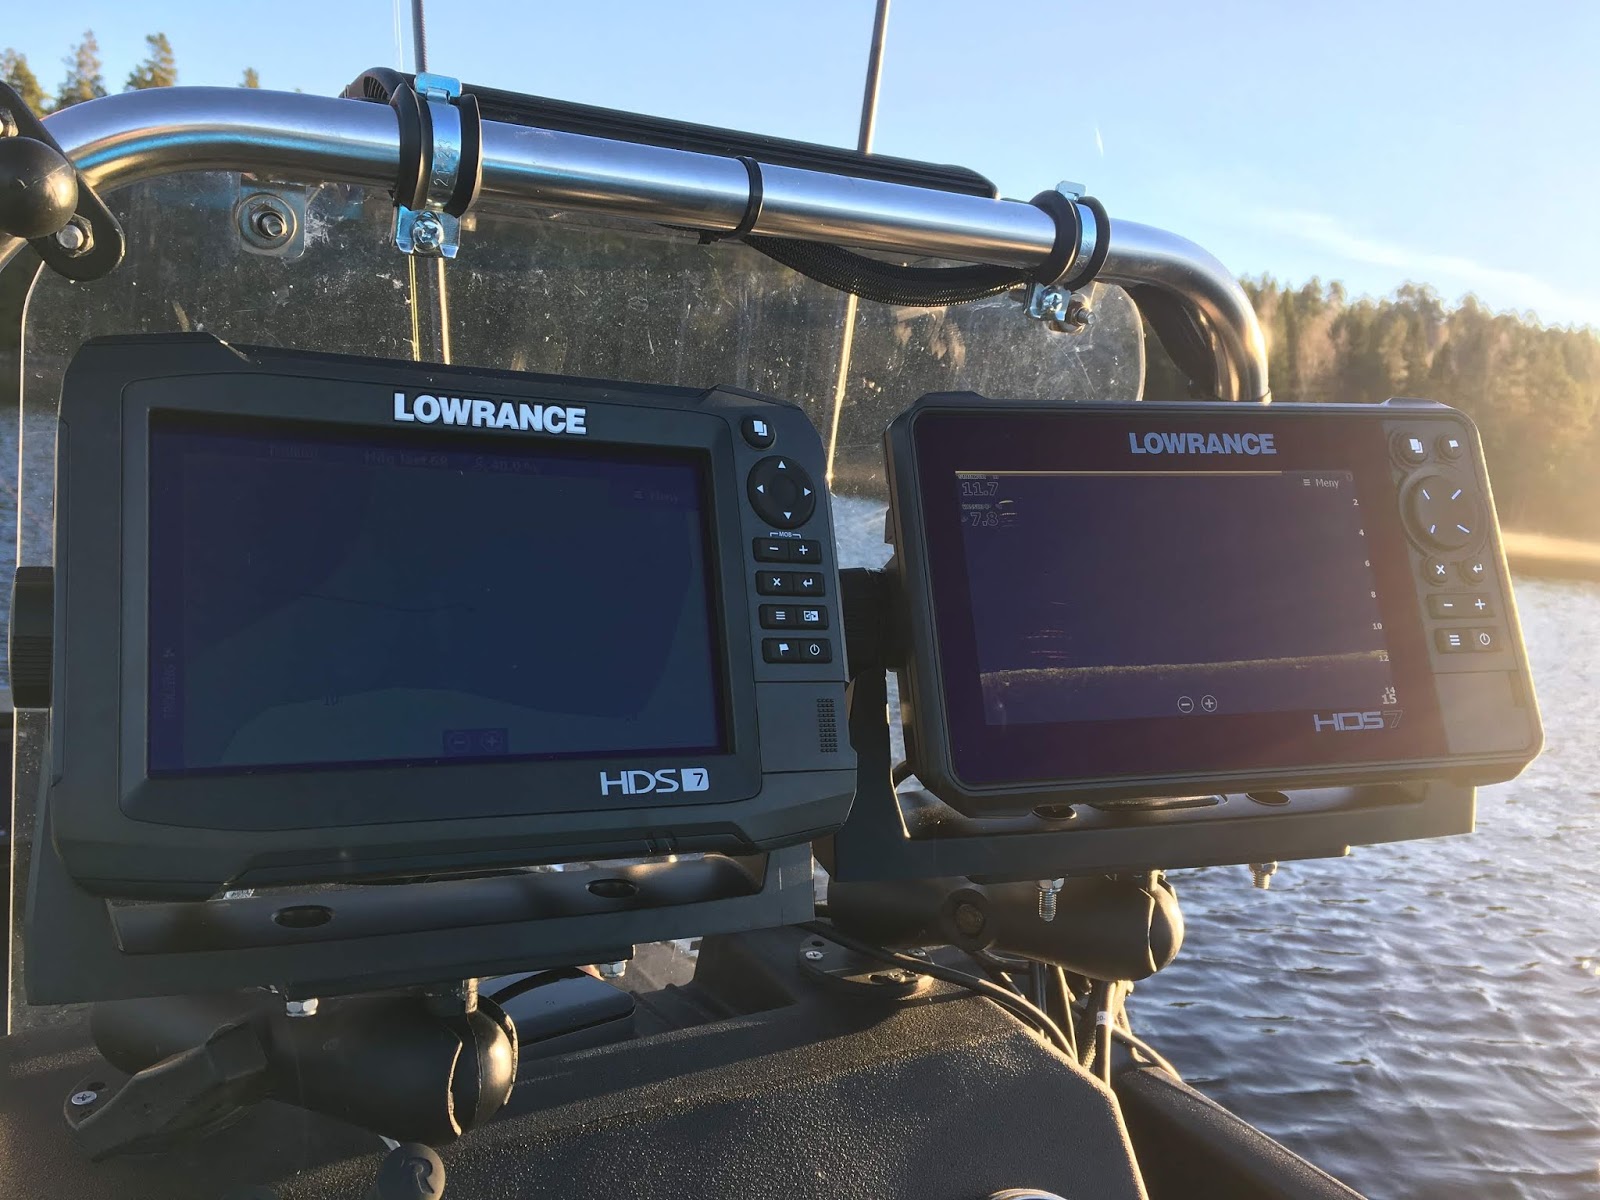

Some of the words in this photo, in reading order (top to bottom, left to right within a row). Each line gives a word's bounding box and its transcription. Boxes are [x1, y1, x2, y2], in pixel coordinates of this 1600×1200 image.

[394, 393, 587, 434] LOWRANCE
[1128, 432, 1277, 455] LOWRANCE
[961, 481, 999, 496] 11.7
[1315, 478, 1340, 489] Meny
[1352, 498, 1360, 506] 2
[970, 511, 999, 527] 7.8
[779, 531, 793, 539] MOB
[1358, 529, 1365, 537] 4
[1370, 591, 1377, 599] 8
[1381, 693, 1397, 705] 15
[600, 768, 679, 796] HDS
